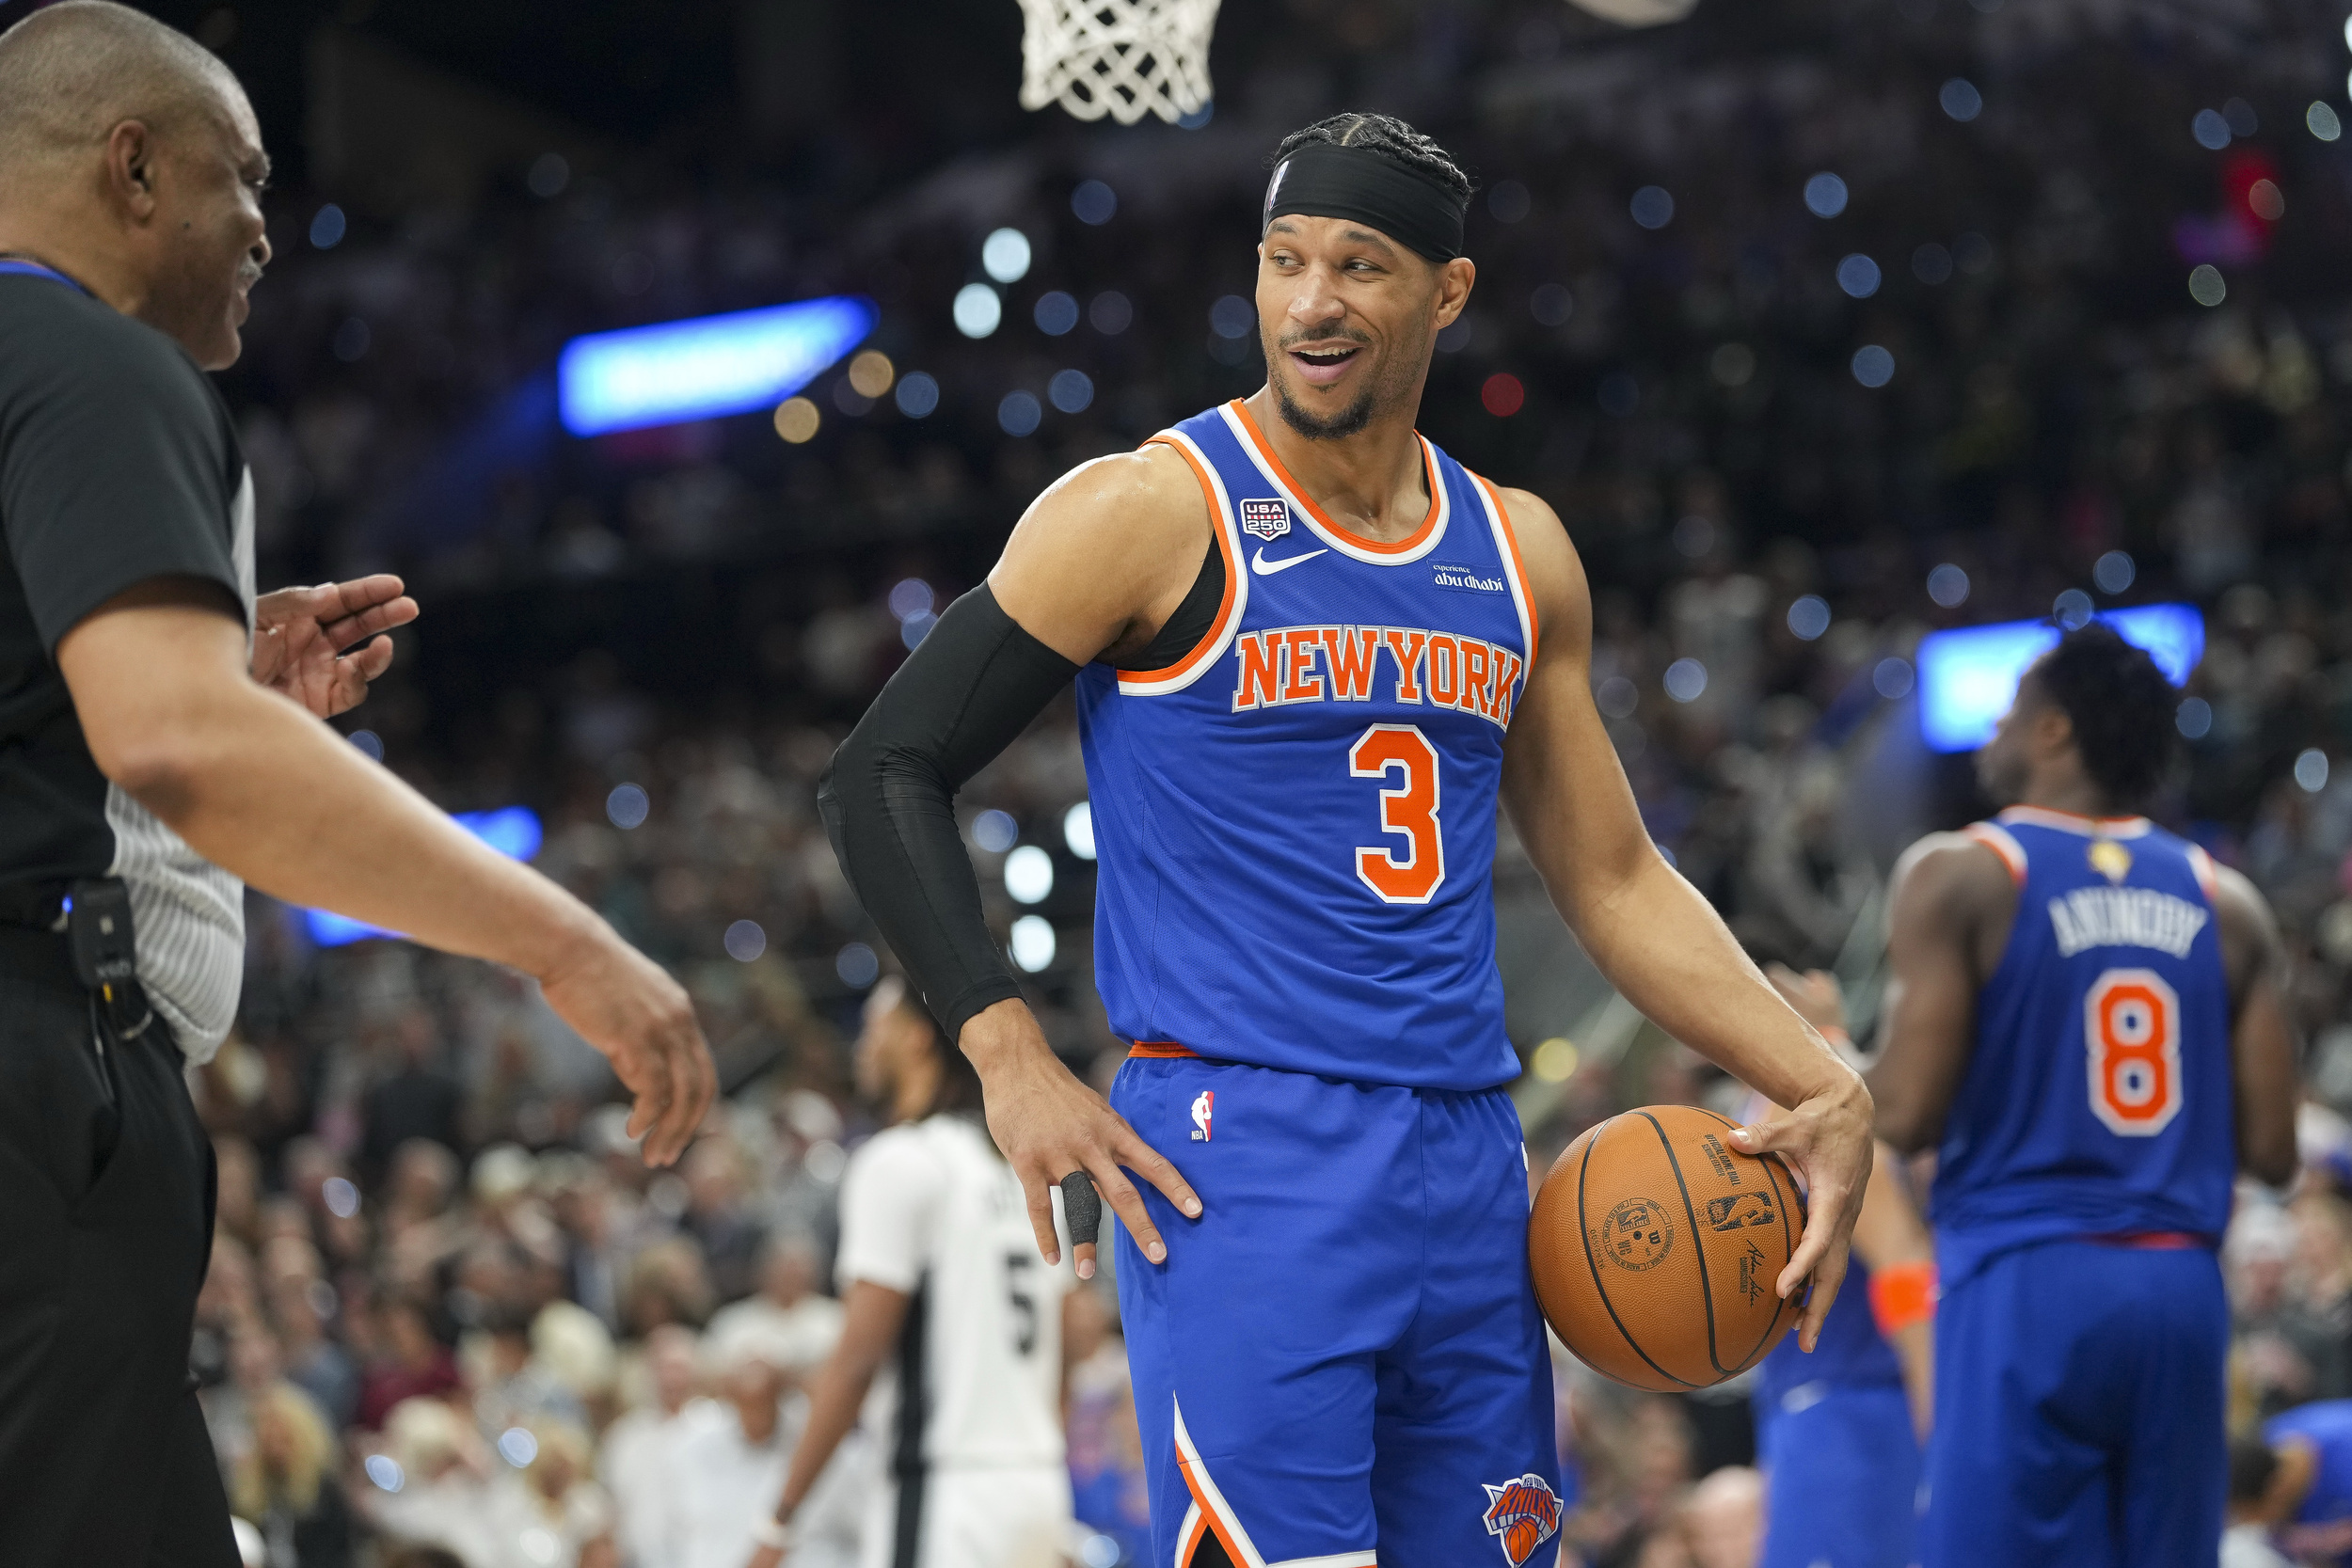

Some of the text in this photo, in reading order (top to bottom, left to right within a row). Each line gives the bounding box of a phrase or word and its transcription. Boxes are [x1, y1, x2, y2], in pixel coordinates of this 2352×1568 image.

[1246, 503, 1283, 514] USA
[1247, 519, 1287, 531] 250
[1433, 564, 1470, 573] experience
[1435, 572, 1504, 592] abu dhabi
[1232, 624, 1524, 734] NEW YORK
[1348, 722, 1446, 905] 3
[2083, 967, 2184, 1137] 8
[1191, 1130, 1203, 1141] NBA
[1002, 1251, 1037, 1356] 5
[1488, 1484, 1557, 1531] KNICKS
